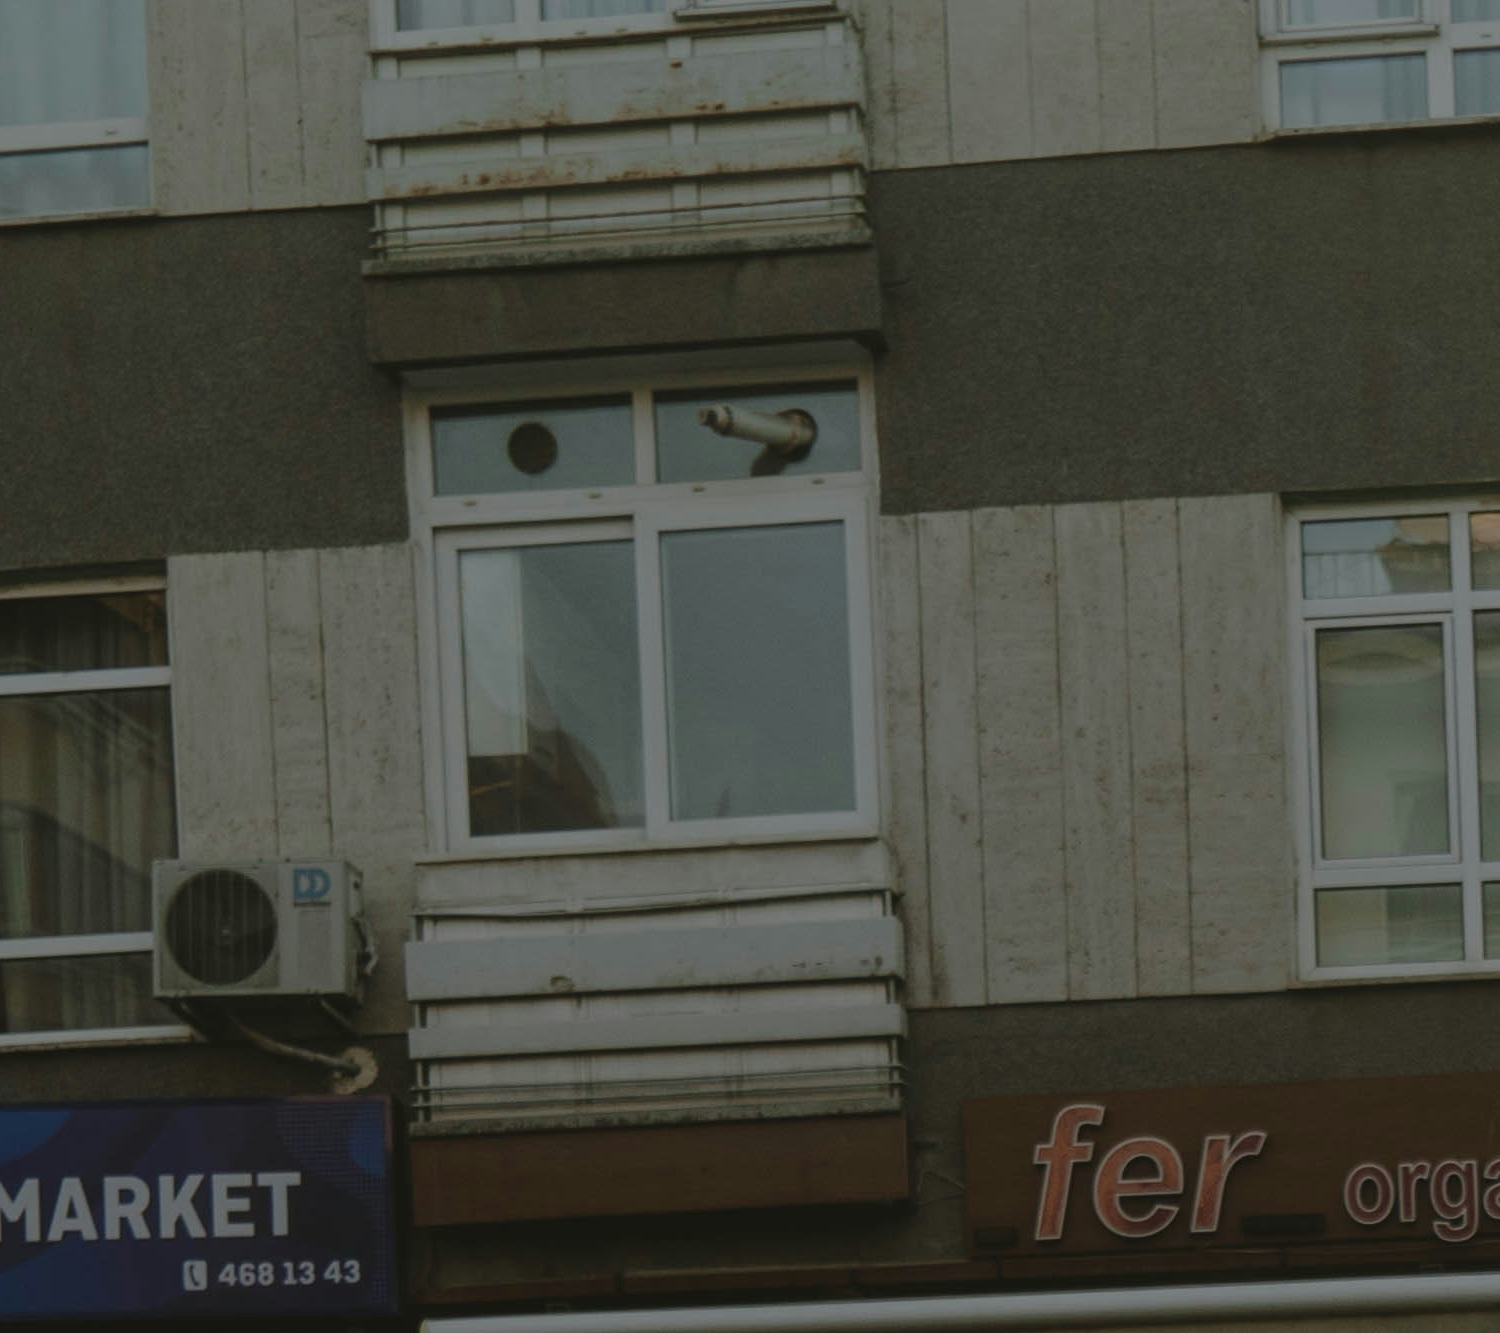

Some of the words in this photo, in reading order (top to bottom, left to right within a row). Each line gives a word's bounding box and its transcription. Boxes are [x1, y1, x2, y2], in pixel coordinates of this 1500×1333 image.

[1033, 1103, 1268, 1241] fer
[217, 1262, 276, 1288] 468
[283, 1262, 316, 1287] 13
[323, 1260, 361, 1286] 43
